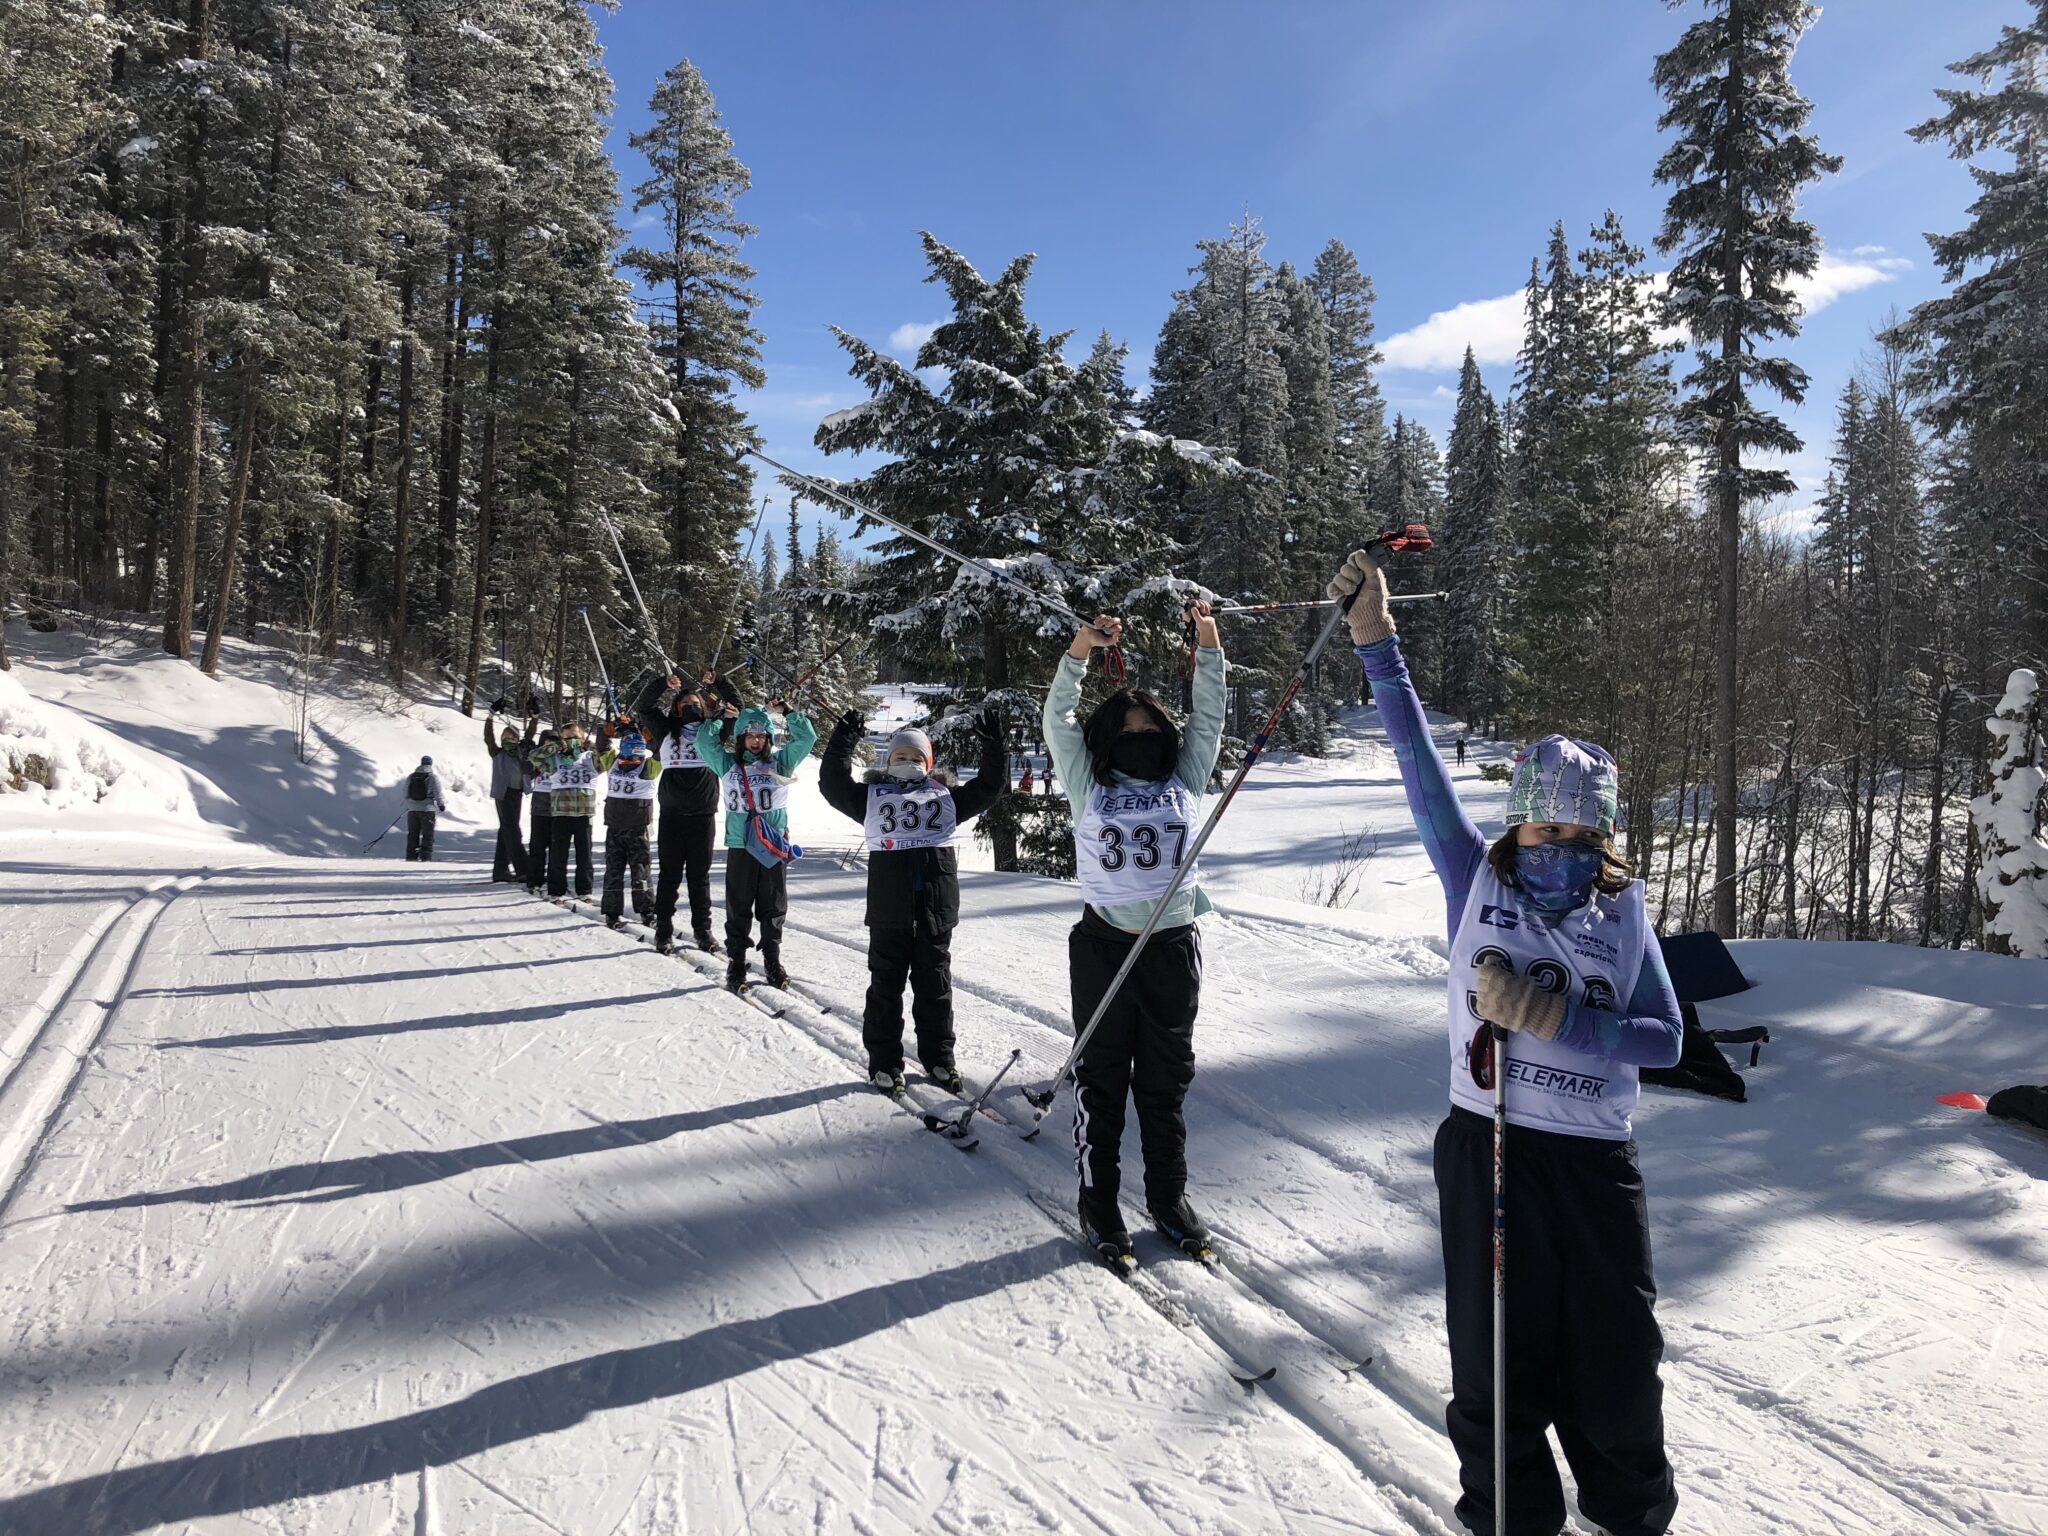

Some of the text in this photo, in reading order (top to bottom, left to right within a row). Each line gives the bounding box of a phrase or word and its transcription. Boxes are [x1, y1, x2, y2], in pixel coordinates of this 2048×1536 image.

[560, 770, 591, 784] 335
[608, 777, 635, 794] 38
[879, 799, 942, 834] 332
[1099, 822, 1188, 872] 337
[1505, 1057, 1608, 1098] ELEMARK
